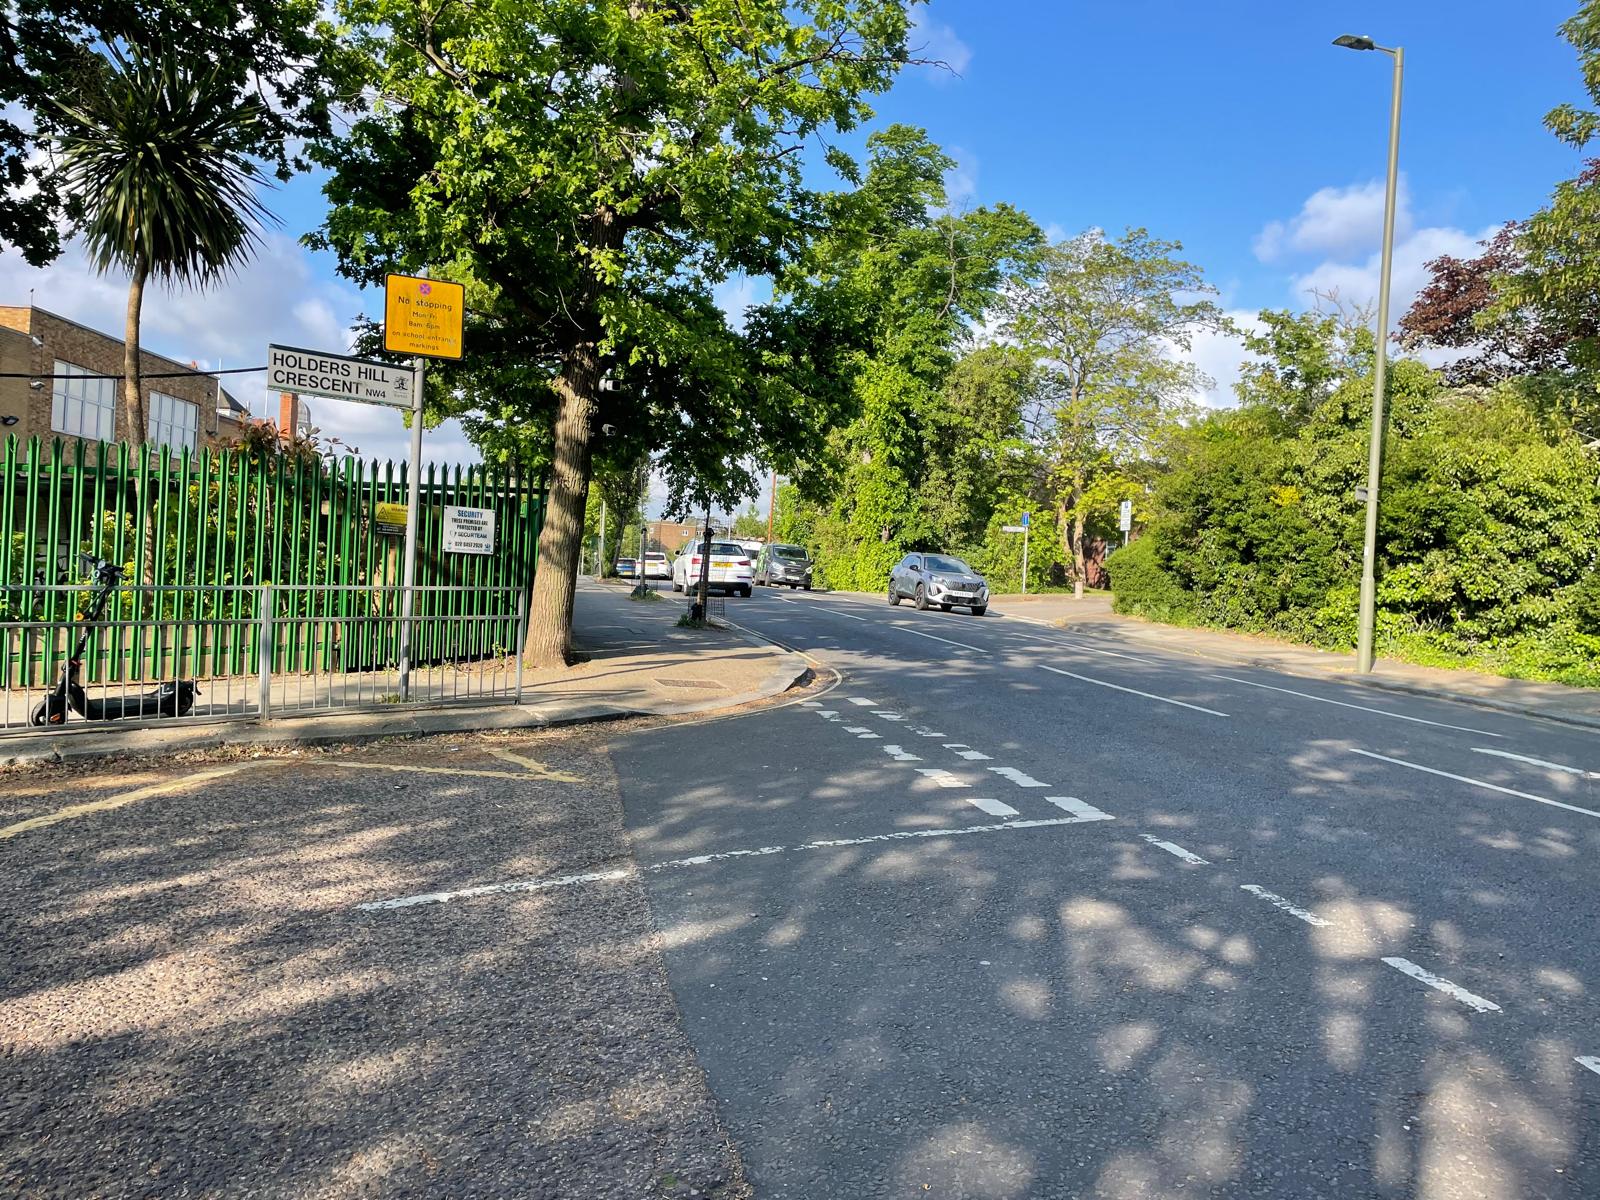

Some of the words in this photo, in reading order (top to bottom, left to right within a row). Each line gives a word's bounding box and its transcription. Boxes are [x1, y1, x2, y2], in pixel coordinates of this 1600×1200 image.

[398, 296, 410, 304] No
[416, 300, 452, 311] stopping
[403, 331, 425, 339] school
[409, 342, 439, 350] markings
[273, 353, 351, 377] HOLDERS
[358, 366, 389, 383] HILL
[273, 370, 362, 394] CRESCENT
[366, 388, 386, 398] NW4
[457, 510, 483, 519] SECURITY
